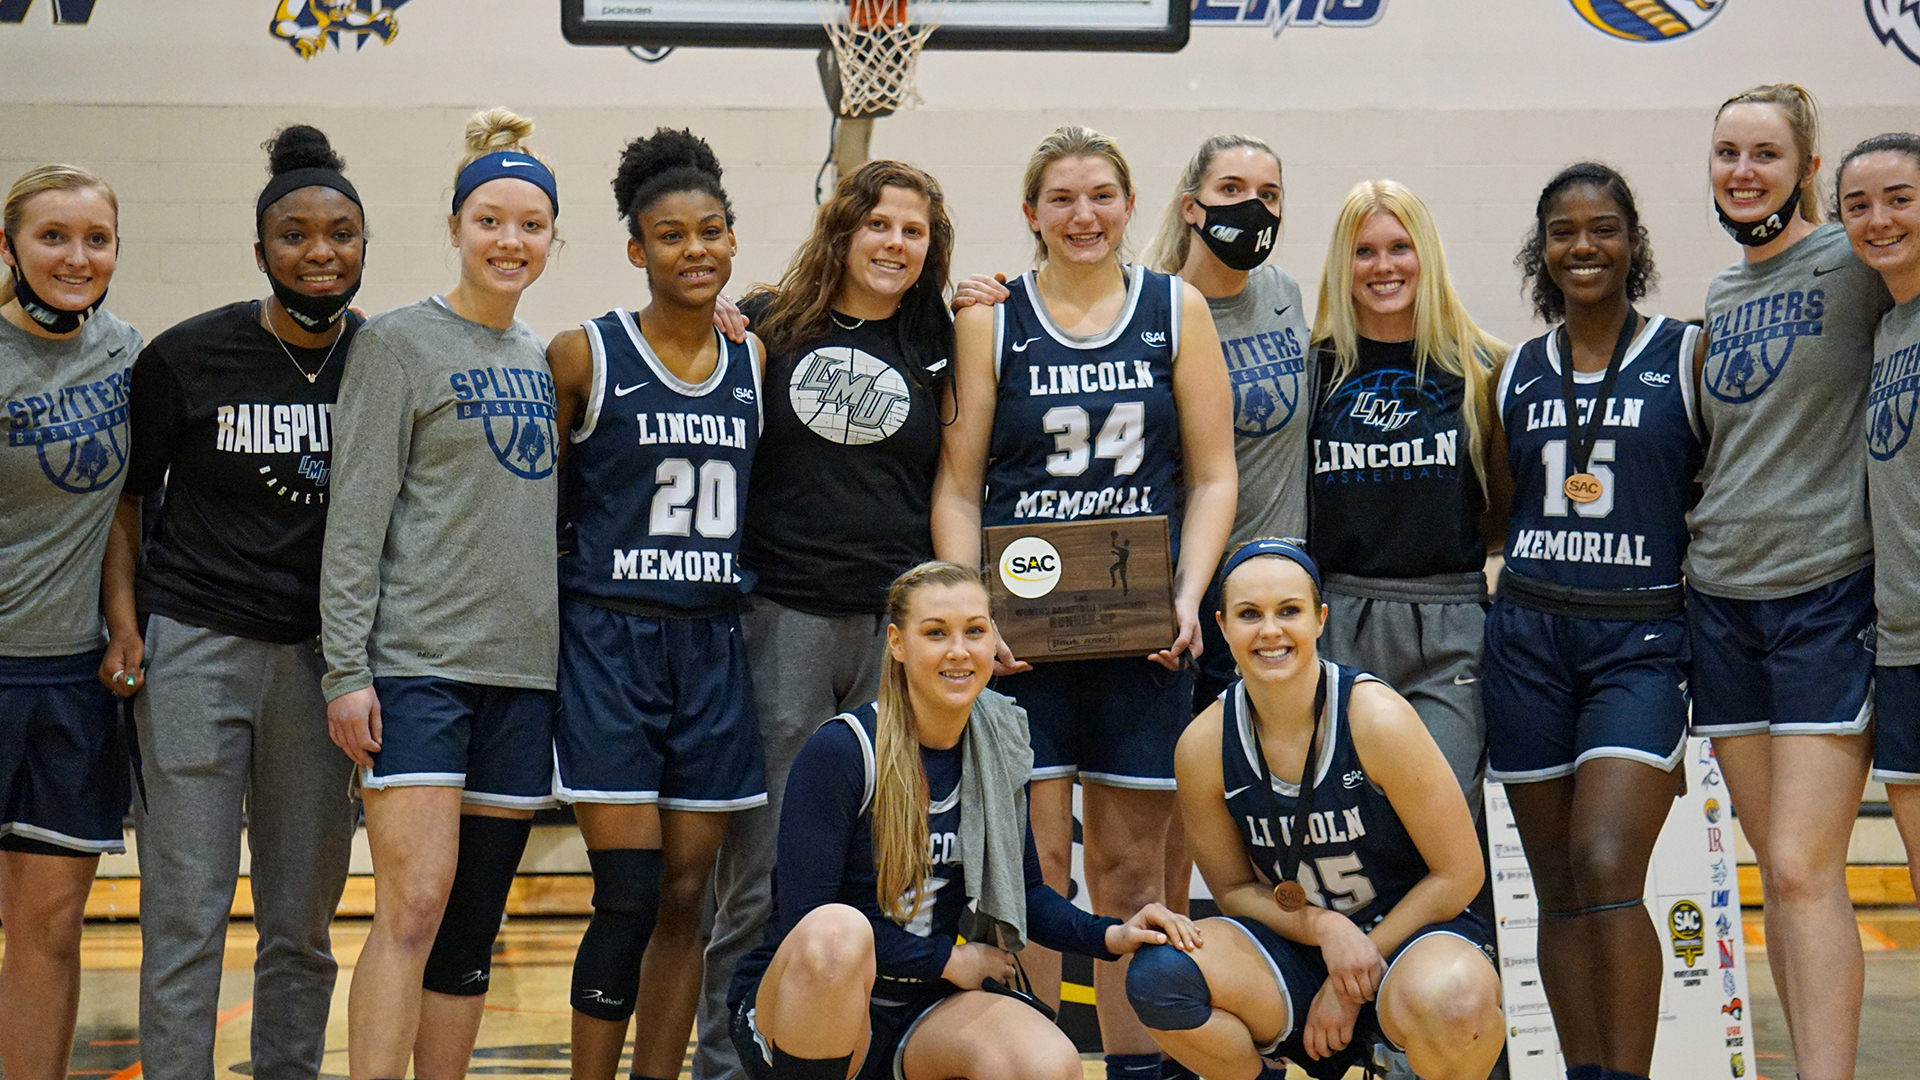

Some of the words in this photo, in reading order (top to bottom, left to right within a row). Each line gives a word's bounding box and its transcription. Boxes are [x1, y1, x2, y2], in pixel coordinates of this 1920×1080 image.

[1254, 226, 1273, 252] 14
[1709, 289, 1825, 342] PLITTERS
[1220, 327, 1302, 370] ITTERS
[1715, 325, 1815, 353] SKETBALL
[1029, 359, 1154, 396] LINCOLN
[1230, 361, 1304, 384] KETBALL
[1643, 371, 1671, 384] SAC
[1871, 342, 1920, 389] PLITTE
[7, 367, 131, 430] SPLITTERS
[450, 367, 557, 408] SPLITTER
[735, 387, 755, 400] SAC
[797, 355, 909, 429] LMU
[16, 406, 128, 444] BASKETBA
[463, 403, 555, 419] BASKETB
[1350, 391, 1418, 432] LMU
[636, 413, 746, 449] LINCOLN
[1042, 401, 1145, 477] 34
[297, 455, 331, 487] LMU
[1313, 429, 1458, 475] LINCOLN
[259, 465, 325, 505] BASKET
[1315, 466, 1457, 485] ASKETBALL
[1541, 439, 1616, 519] 15
[1569, 480, 1599, 495] SAC
[649, 458, 737, 539] 20
[1014, 486, 1153, 520] MEMORIAL
[1012, 554, 1056, 574] SAC
[1511, 529, 1652, 567] MEMORIAL
[1246, 805, 1366, 848] LINOLN
[1673, 910, 1701, 932] SAC
